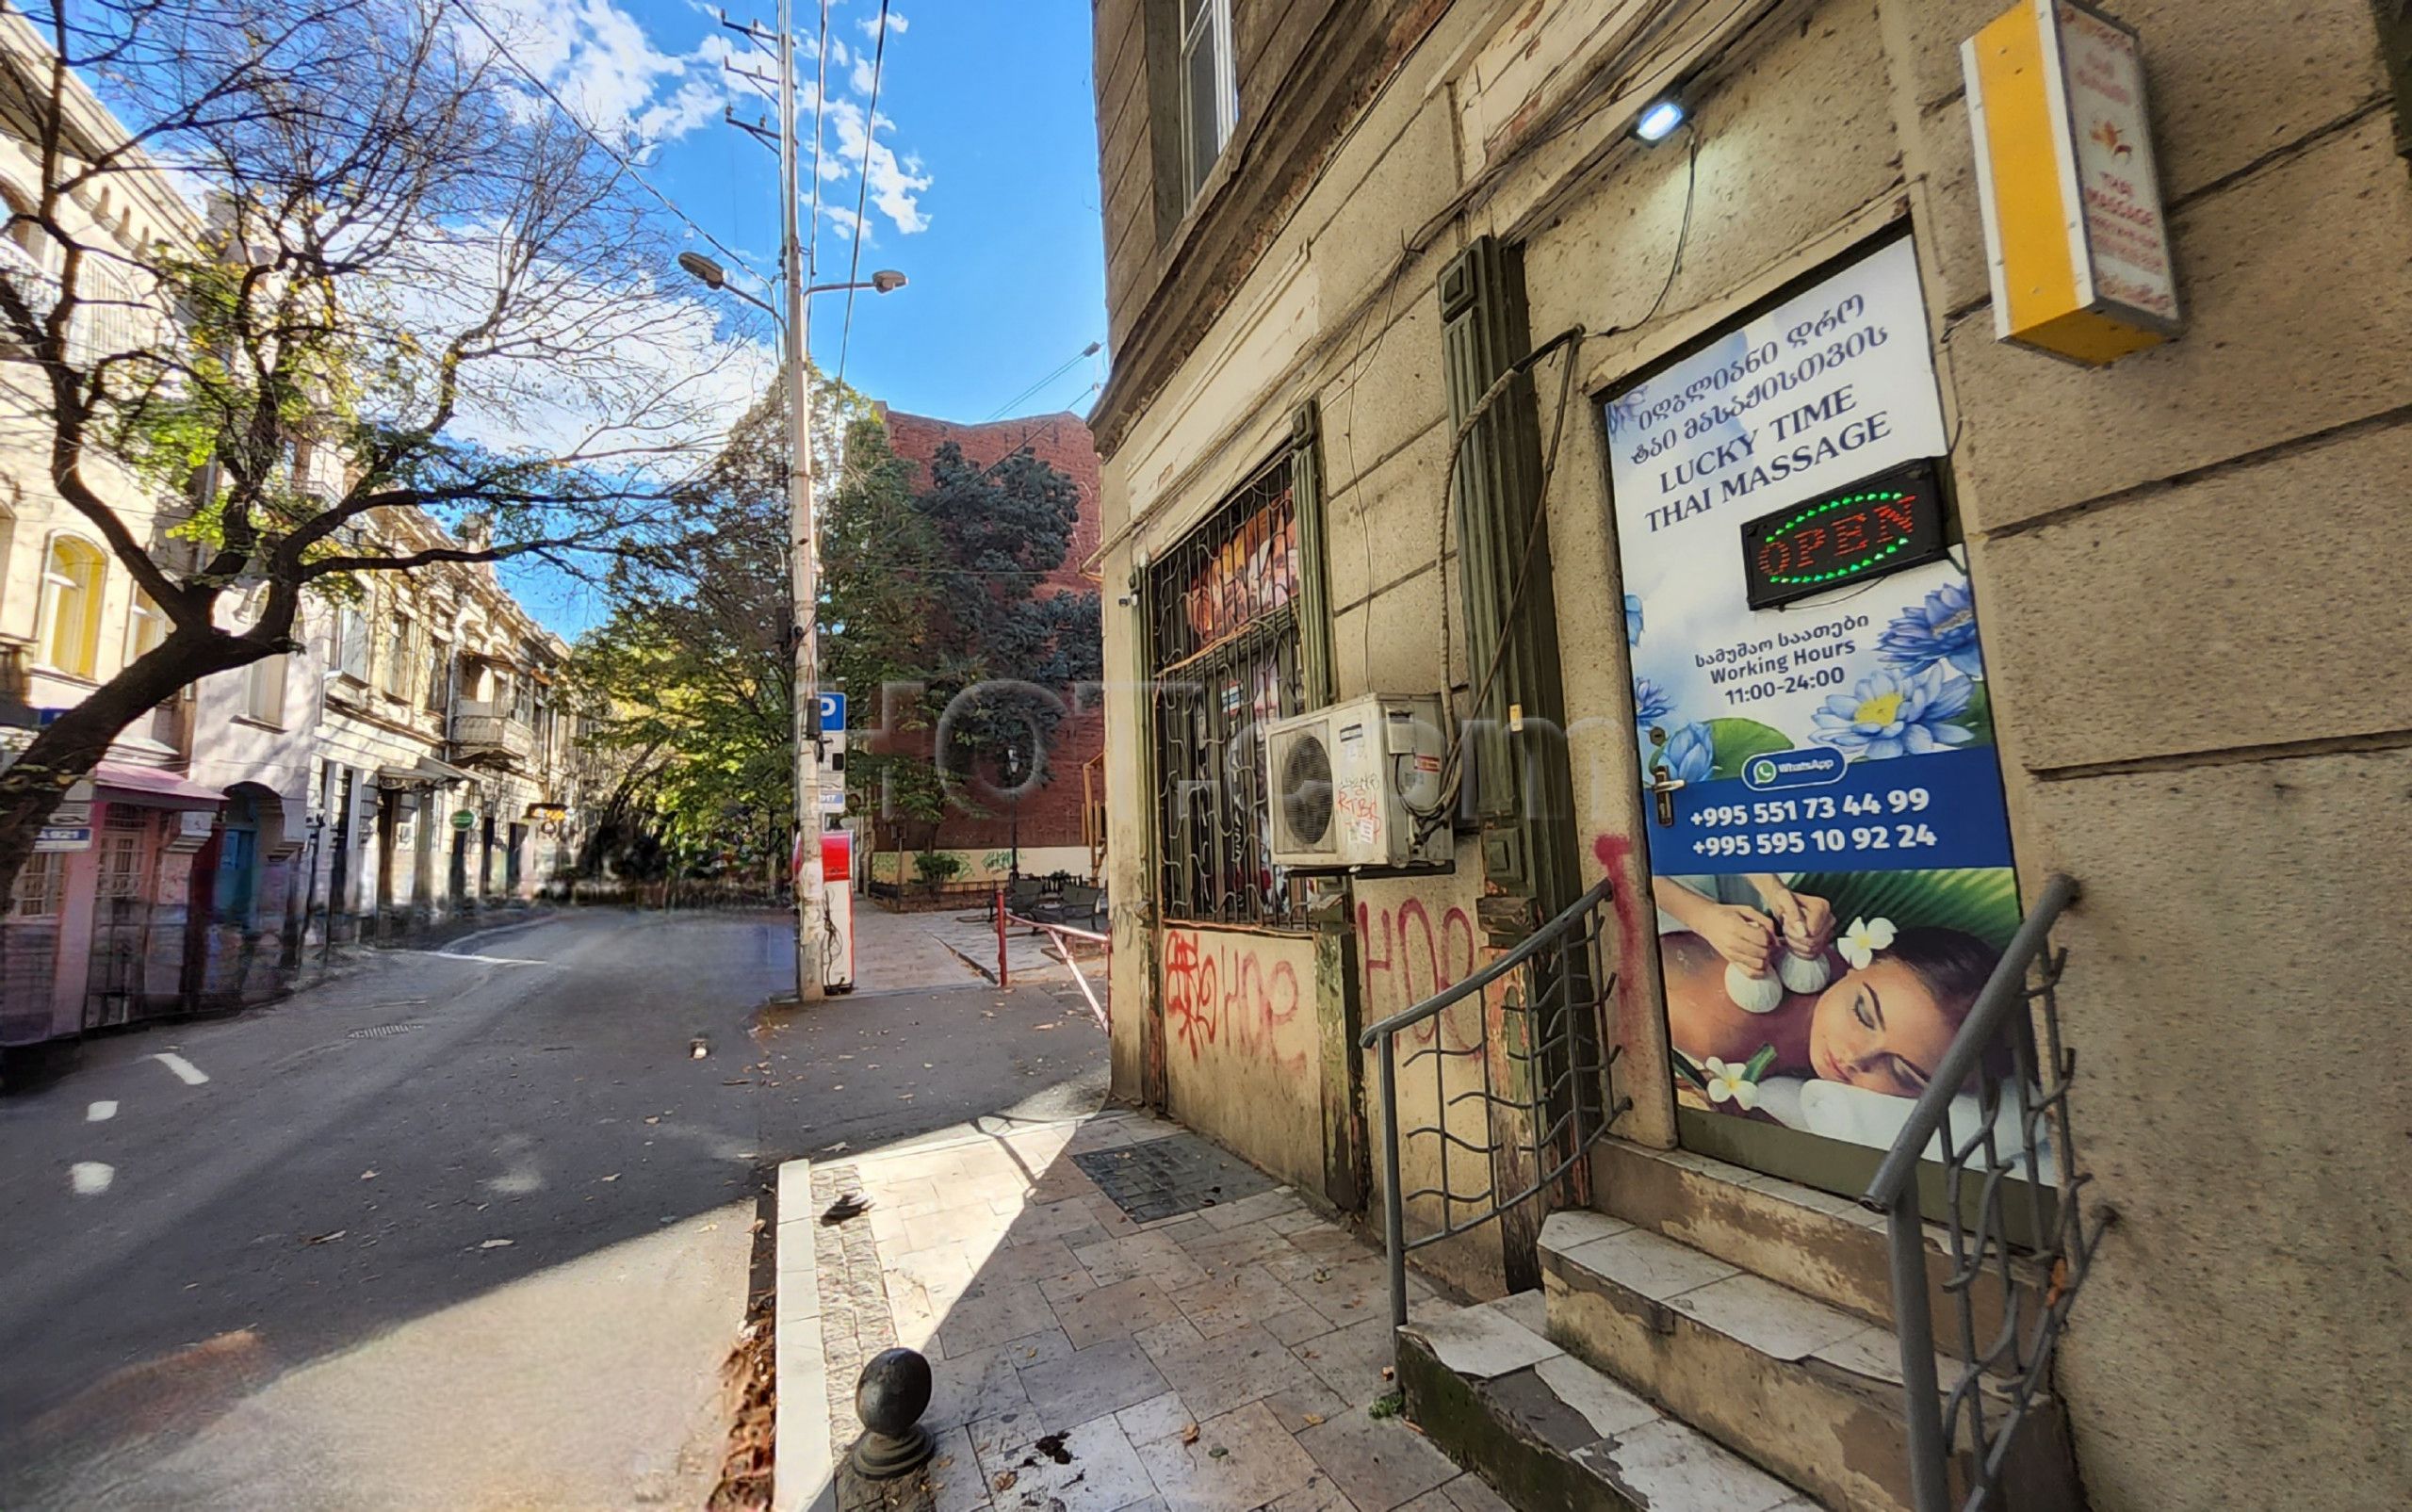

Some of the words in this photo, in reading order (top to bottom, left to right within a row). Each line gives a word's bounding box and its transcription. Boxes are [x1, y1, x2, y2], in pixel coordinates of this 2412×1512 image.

[1786, 293, 1865, 349] დრო
[1631, 433, 1677, 464] ტაი
[1684, 325, 1889, 438] მასაჟისთვის
[1659, 430, 1759, 494] LUCKY
[1769, 384, 1858, 443] TIME
[1644, 487, 1713, 533] THAI
[1720, 411, 1893, 502] MASSAGE
[1758, 495, 1918, 576] OPEN
[1695, 638, 1773, 668] სამუშაო
[1778, 614, 1869, 647] საათები
[1710, 654, 1789, 685] Working
[1794, 640, 1856, 667] Hours
[1724, 666, 1845, 705] 11:00-24:00
[1778, 757, 1834, 774] WhatsApp
[1690, 805, 1748, 827] +995
[1753, 801, 1797, 823] 551
[1802, 797, 1836, 820] 73
[1842, 793, 1882, 816] 44
[1887, 788, 1930, 813] 99
[1693, 834, 1751, 856] +995
[1756, 831, 1805, 854] 595
[1811, 829, 1845, 852] 10
[1851, 826, 1890, 850] 92
[1896, 824, 1937, 847] 24
